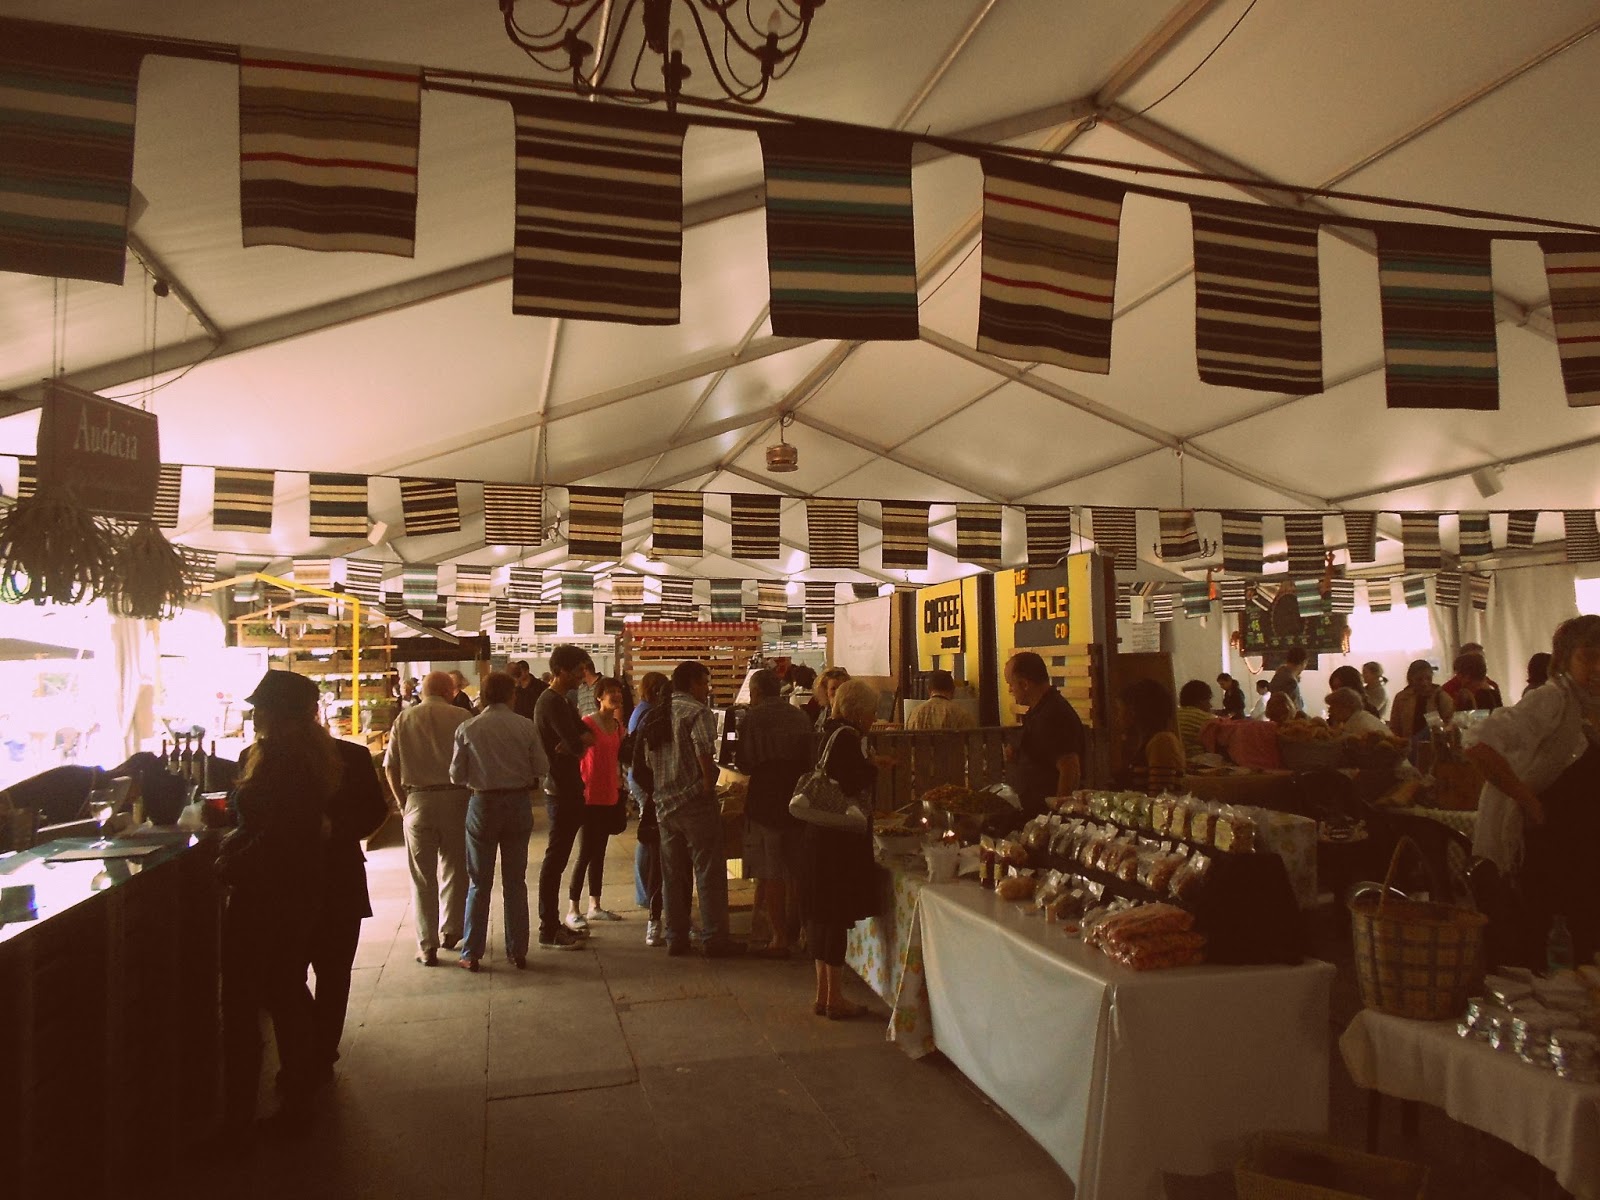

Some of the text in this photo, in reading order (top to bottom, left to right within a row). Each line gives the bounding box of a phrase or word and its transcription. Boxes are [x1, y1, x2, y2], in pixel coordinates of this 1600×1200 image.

[74, 404, 138, 460] Audacia
[924, 594, 960, 634] COFFEE
[1012, 586, 1067, 624] JAFFLE
[1055, 623, 1067, 639] CO
